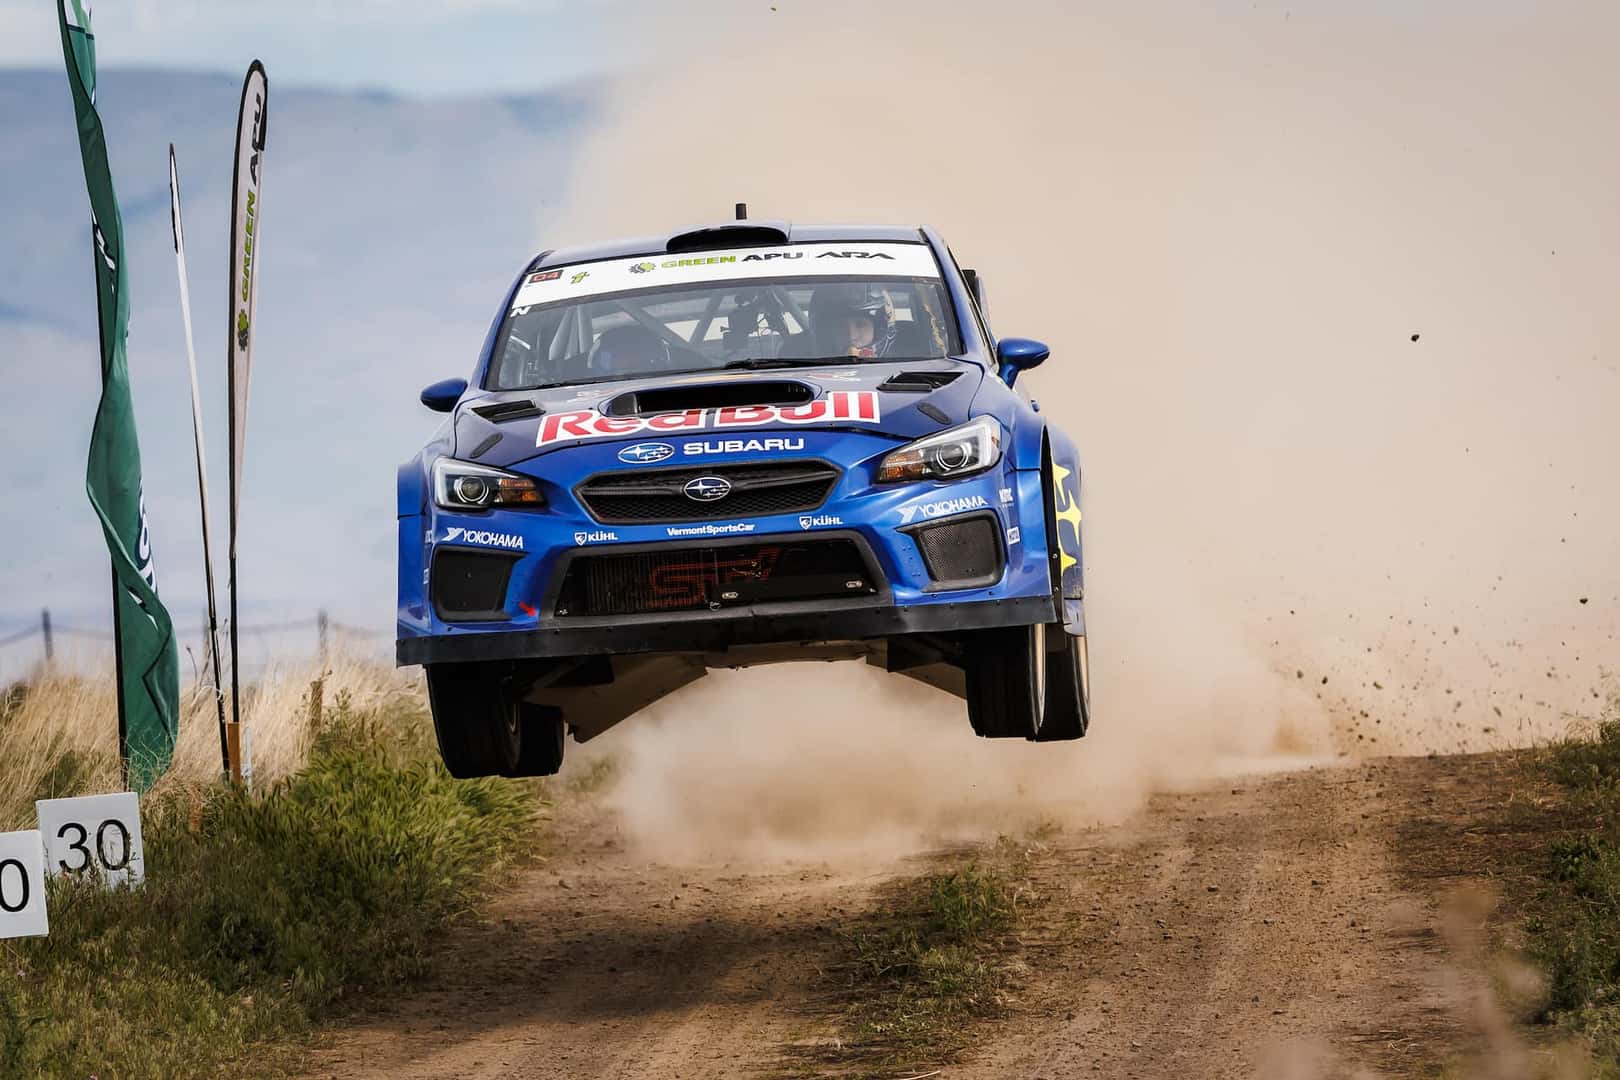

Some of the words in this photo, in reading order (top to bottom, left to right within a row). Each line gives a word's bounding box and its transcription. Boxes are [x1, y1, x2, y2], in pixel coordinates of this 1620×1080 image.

[242, 190, 256, 303] GREEN
[815, 250, 896, 260] ARA
[661, 255, 737, 269] GREEN
[741, 251, 804, 263] APU
[536, 408, 706, 447] Red
[714, 391, 880, 424] Bull
[684, 438, 804, 455] SUBARU
[919, 495, 988, 517] YOKOHAMA
[813, 515, 844, 526] KÜHL
[462, 529, 524, 549] YOKOHAMA
[588, 531, 619, 542] KÜHL
[666, 523, 755, 537] VermontSportsCar
[57, 819, 131, 874] 30
